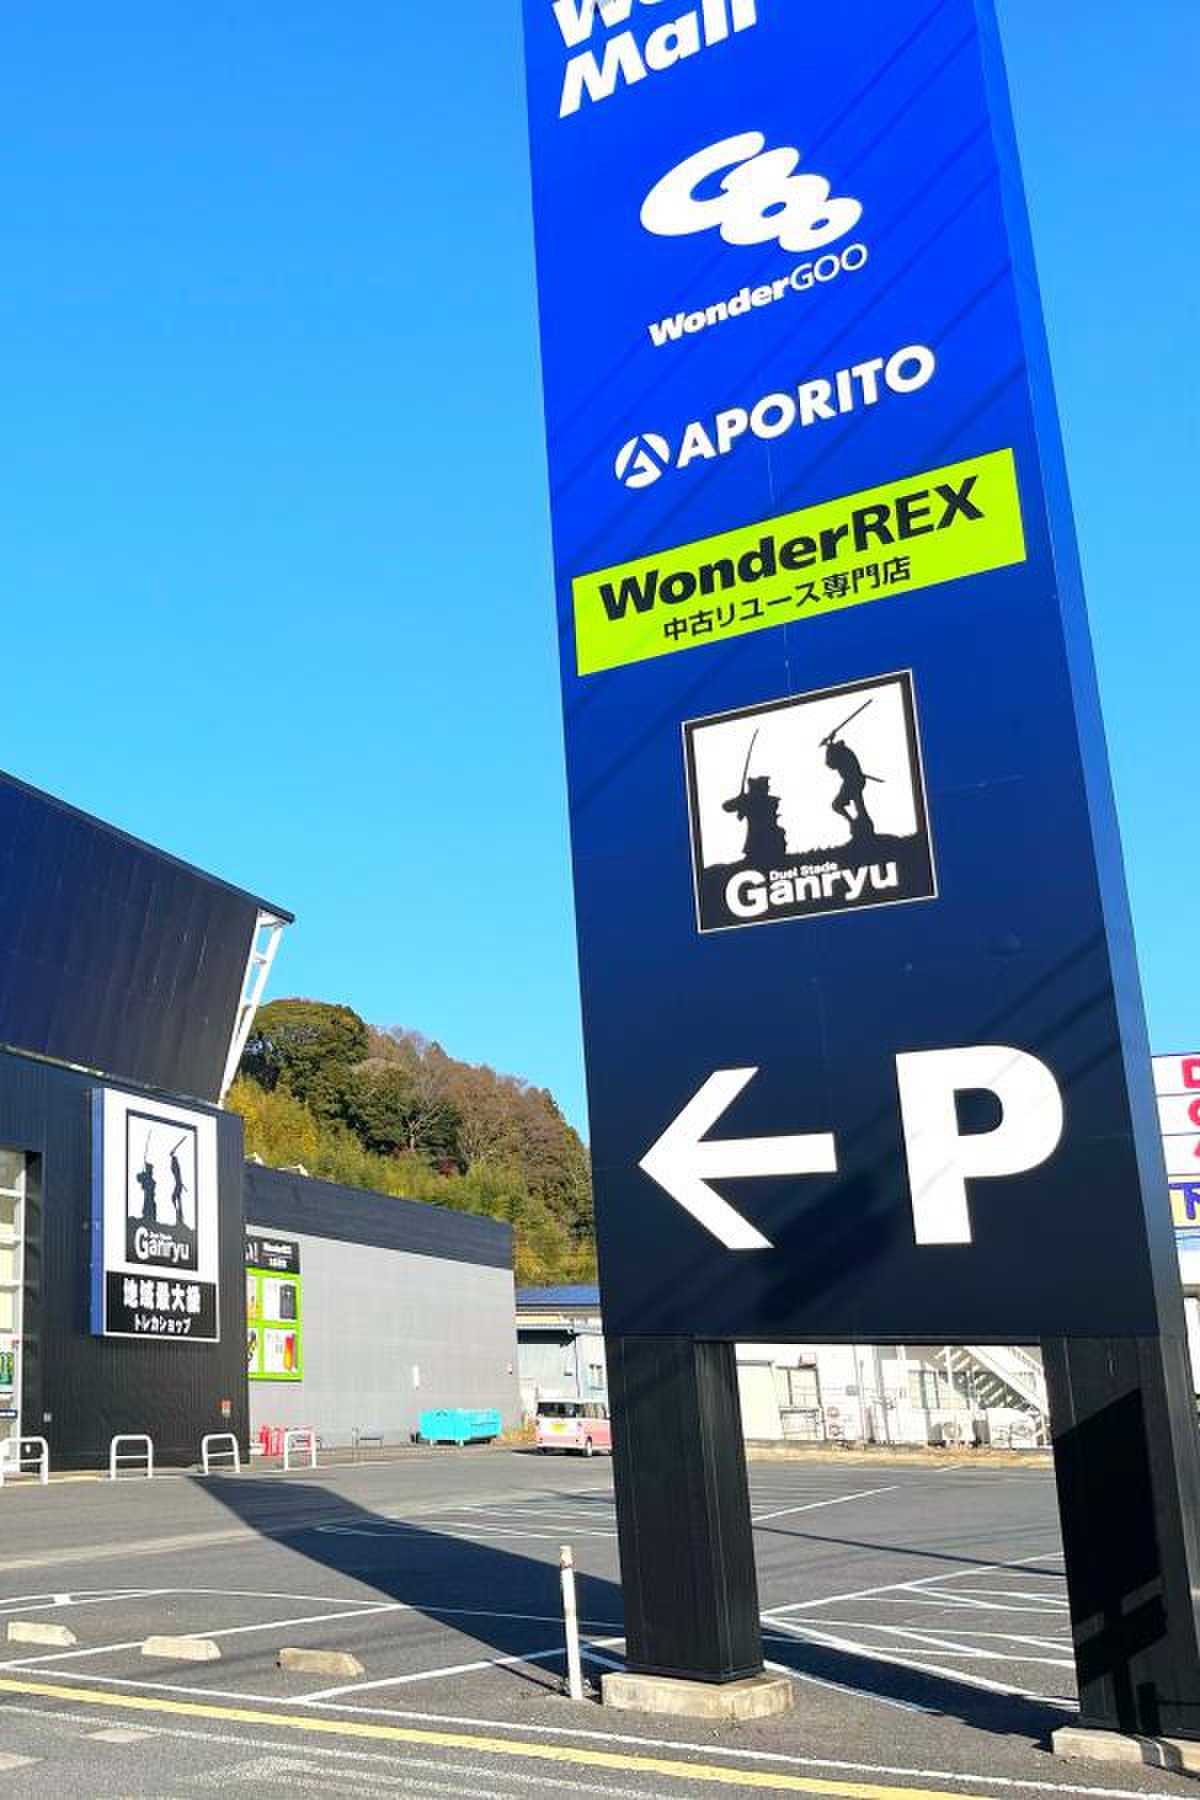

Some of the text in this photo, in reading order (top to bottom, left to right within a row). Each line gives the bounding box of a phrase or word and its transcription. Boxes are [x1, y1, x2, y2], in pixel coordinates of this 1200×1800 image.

[559, 0, 757, 118] Mall
[648, 242, 868, 347] WonderGOO
[676, 344, 936, 469] APORITO
[599, 475, 984, 622] WonderREX
[663, 556, 912, 641] 中古リユース専門店
[725, 861, 898, 918] Ganryu
[895, 1044, 1064, 1245] P
[134, 1226, 190, 1263] Ganryu
